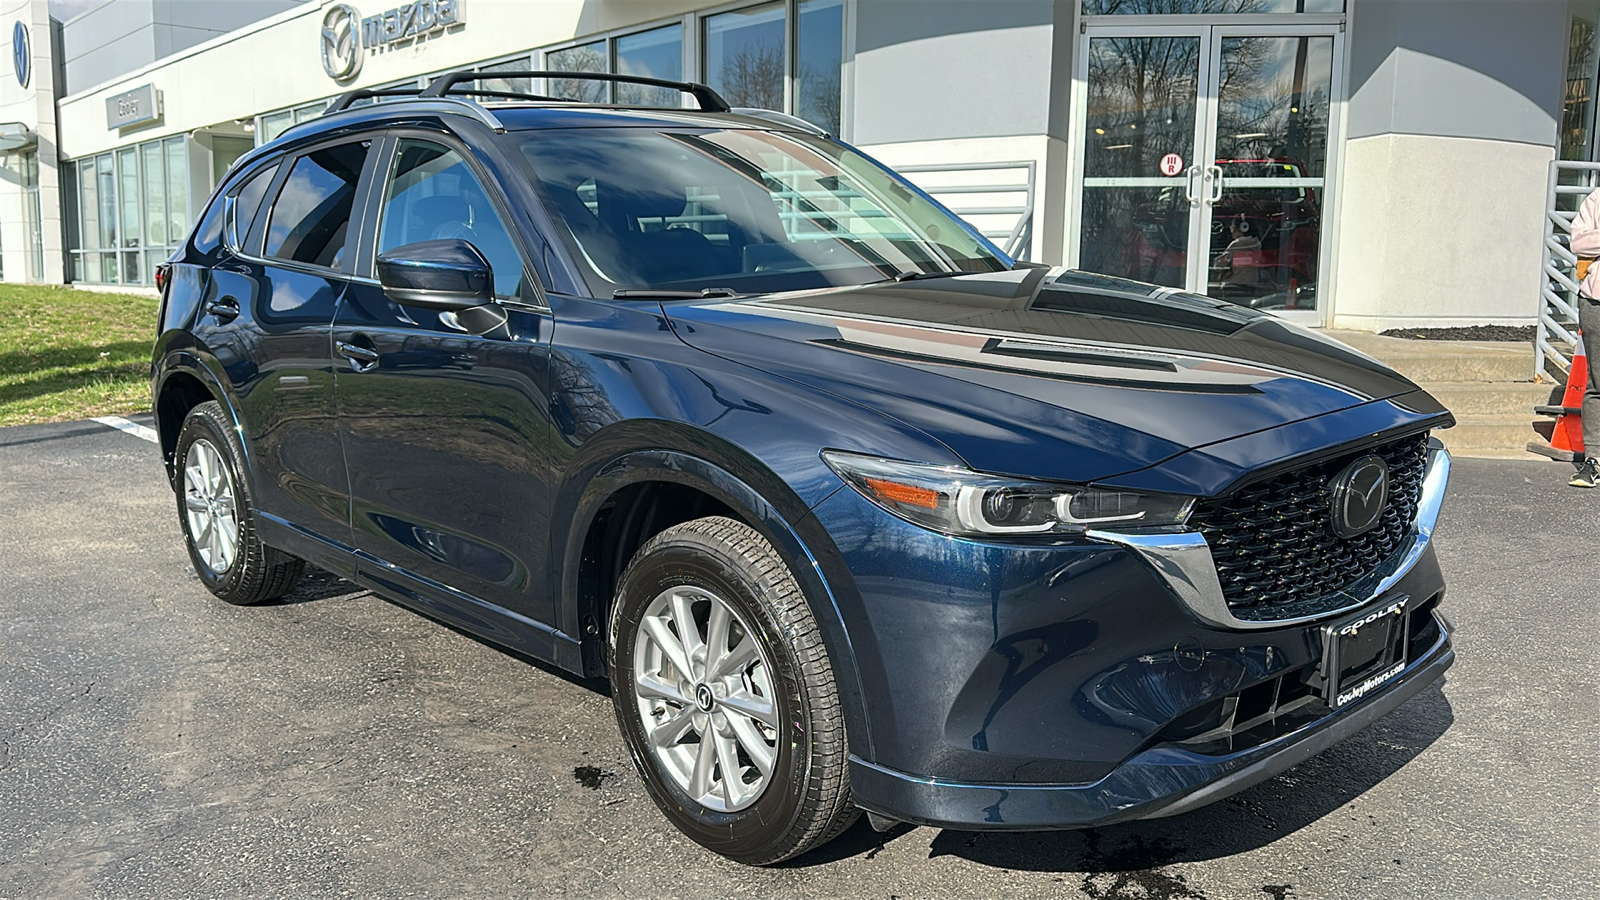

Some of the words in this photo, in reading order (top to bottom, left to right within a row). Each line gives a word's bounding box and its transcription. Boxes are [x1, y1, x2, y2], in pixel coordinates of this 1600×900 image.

[362, 0, 456, 49] mazda
[117, 94, 139, 118] Cooley
[1168, 165, 1175, 173] R
[1340, 598, 1409, 636] COOLEY
[1336, 662, 1406, 707] CooleyMotors.com
